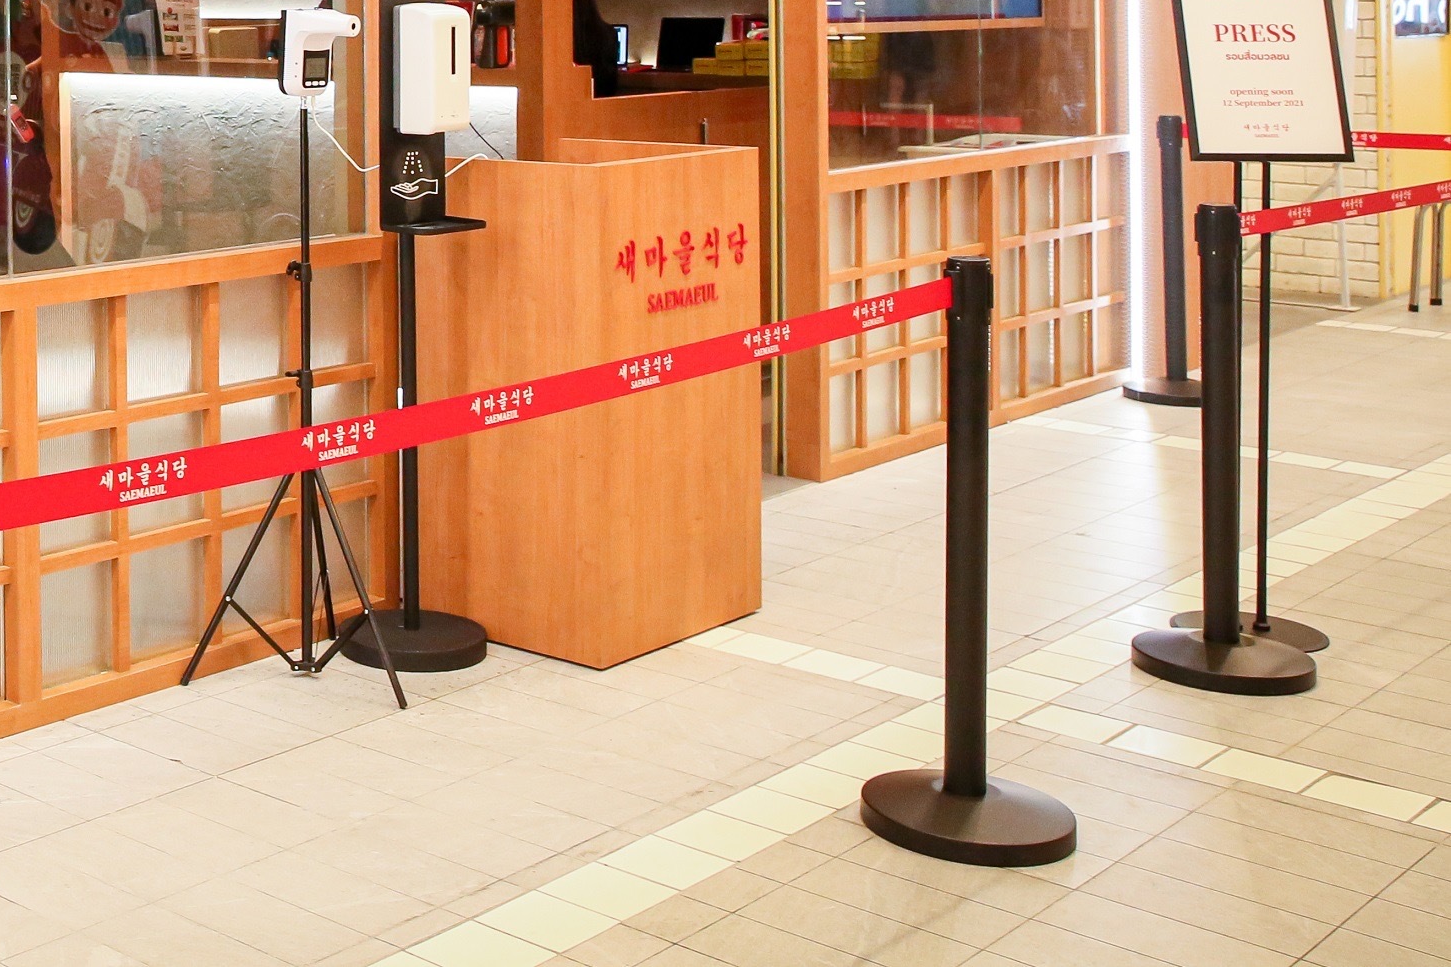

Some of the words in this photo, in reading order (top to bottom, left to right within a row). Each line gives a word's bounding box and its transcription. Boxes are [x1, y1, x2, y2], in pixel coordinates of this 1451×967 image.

[1213, 23, 1297, 43] PRESS
[1225, 50, 1290, 61] รอบสื่อมวลชน
[1230, 88, 1269, 97] opening
[1222, 99, 1232, 107] 12
[1234, 99, 1281, 108] September
[1284, 99, 1304, 107] 2021
[614, 223, 749, 284] 새마을식당
[646, 282, 718, 314] SAEMAEUL
[852, 297, 895, 320] 새마을식당
[743, 324, 791, 349] 새마을식당
[617, 353, 673, 382] 새마을식당
[630, 374, 661, 390] SAEMAEUL
[469, 385, 534, 417] 새마을식당
[484, 409, 519, 426] SAEMAEUL
[300, 419, 377, 452] 새마을식당
[318, 444, 359, 463] SAEMAEUL
[98, 456, 188, 492] 새마을식당
[119, 483, 167, 503] SAEMAEUL
